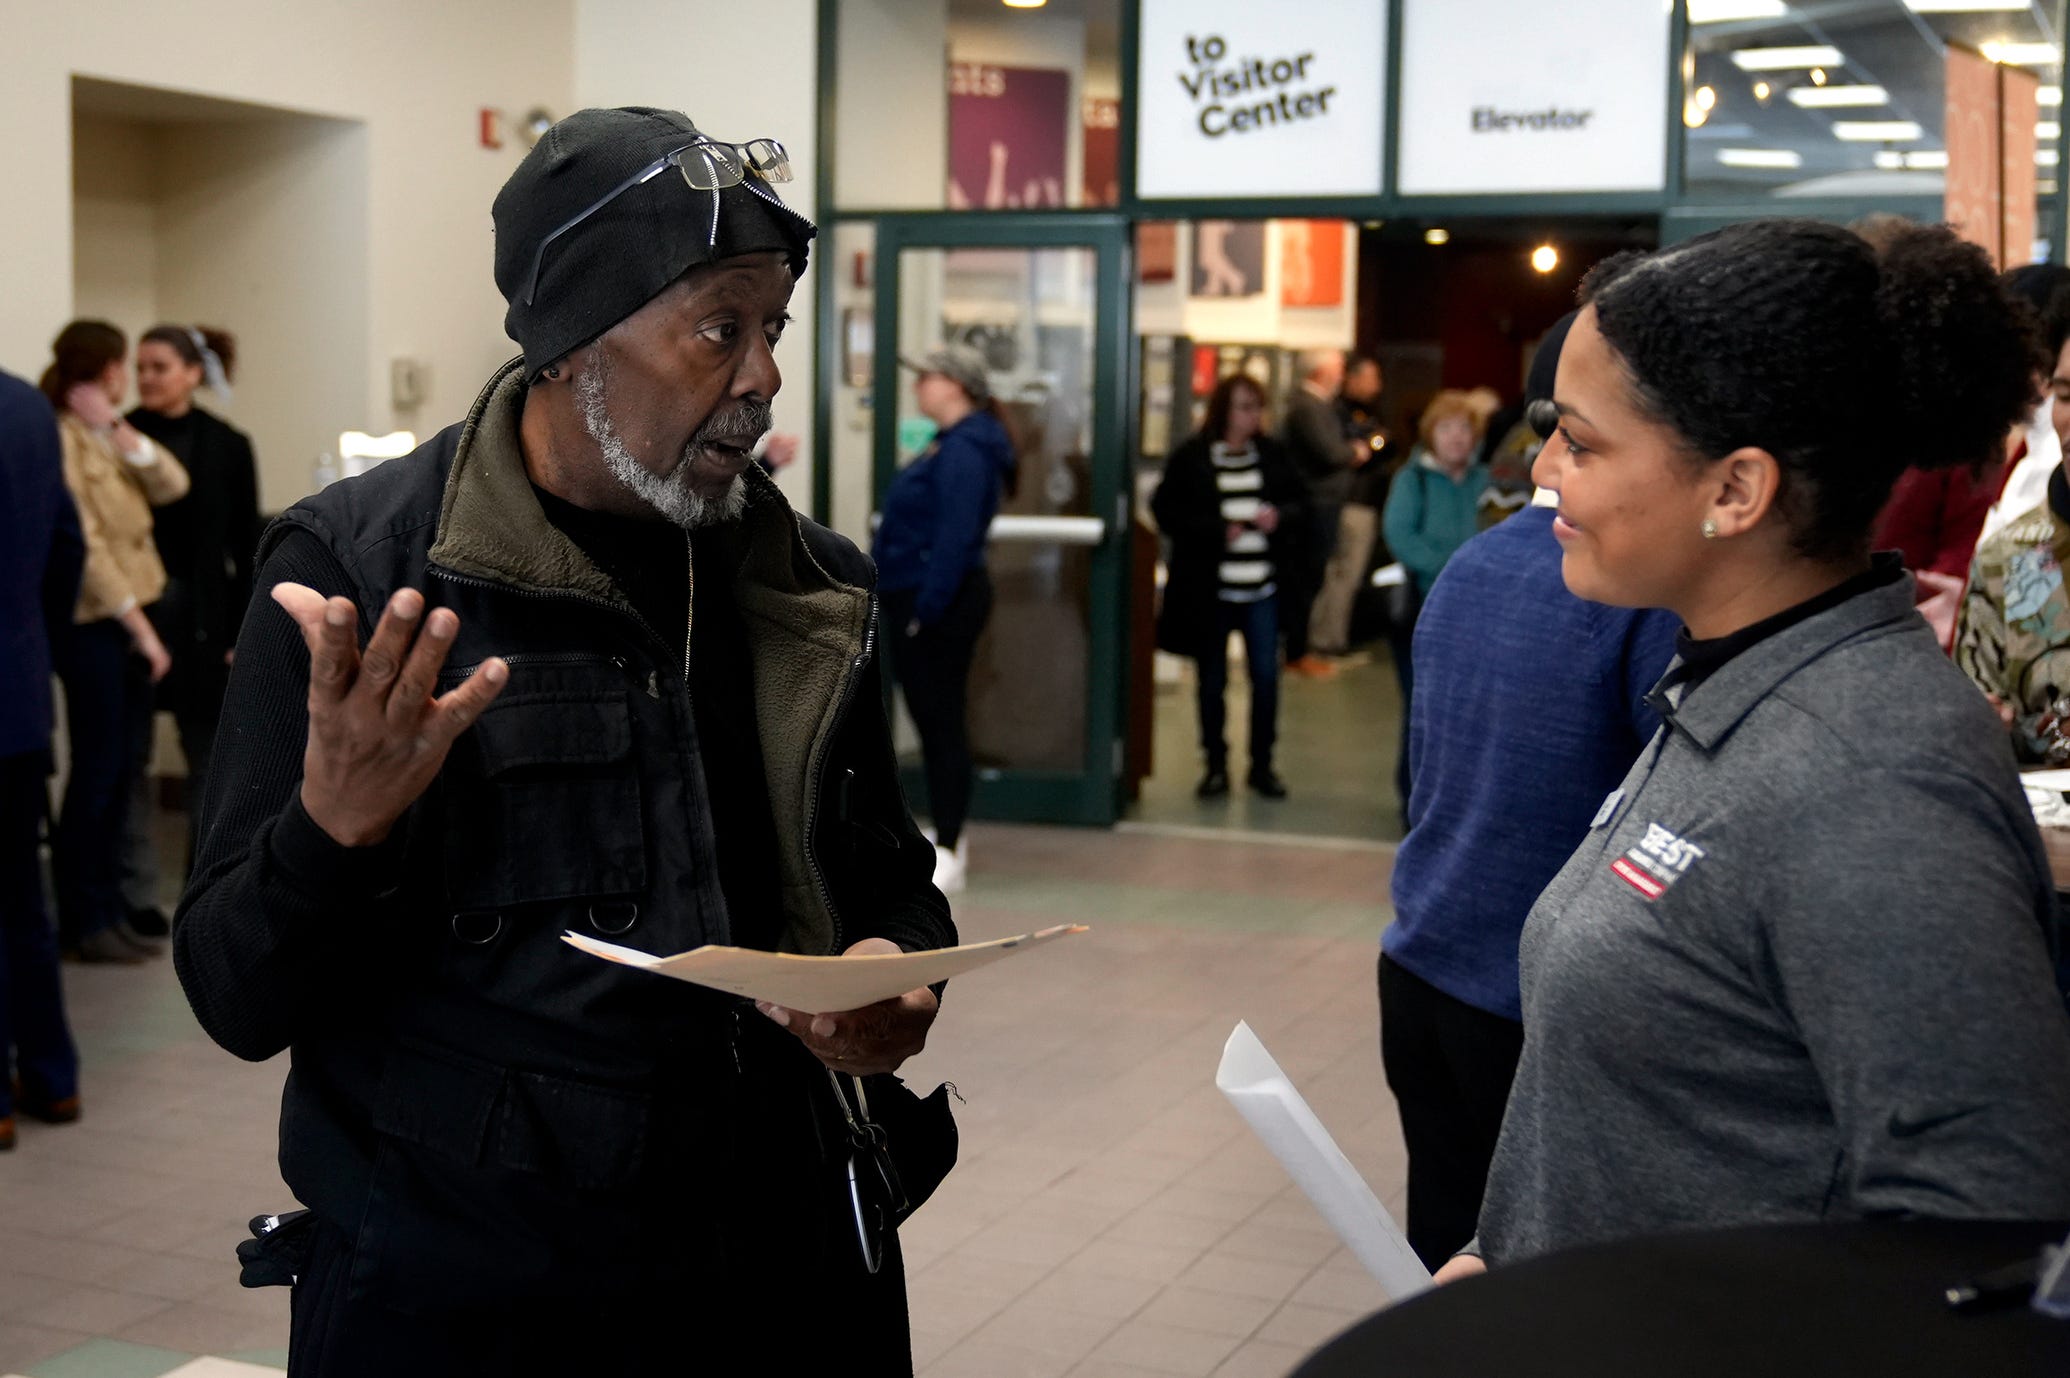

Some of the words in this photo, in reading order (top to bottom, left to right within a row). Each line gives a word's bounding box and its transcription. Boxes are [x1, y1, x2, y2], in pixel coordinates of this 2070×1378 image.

[1185, 34, 1228, 64] to
[1177, 52, 1315, 99] Visitor
[1198, 86, 1338, 138] Center
[1470, 106, 1595, 133] Elevator
